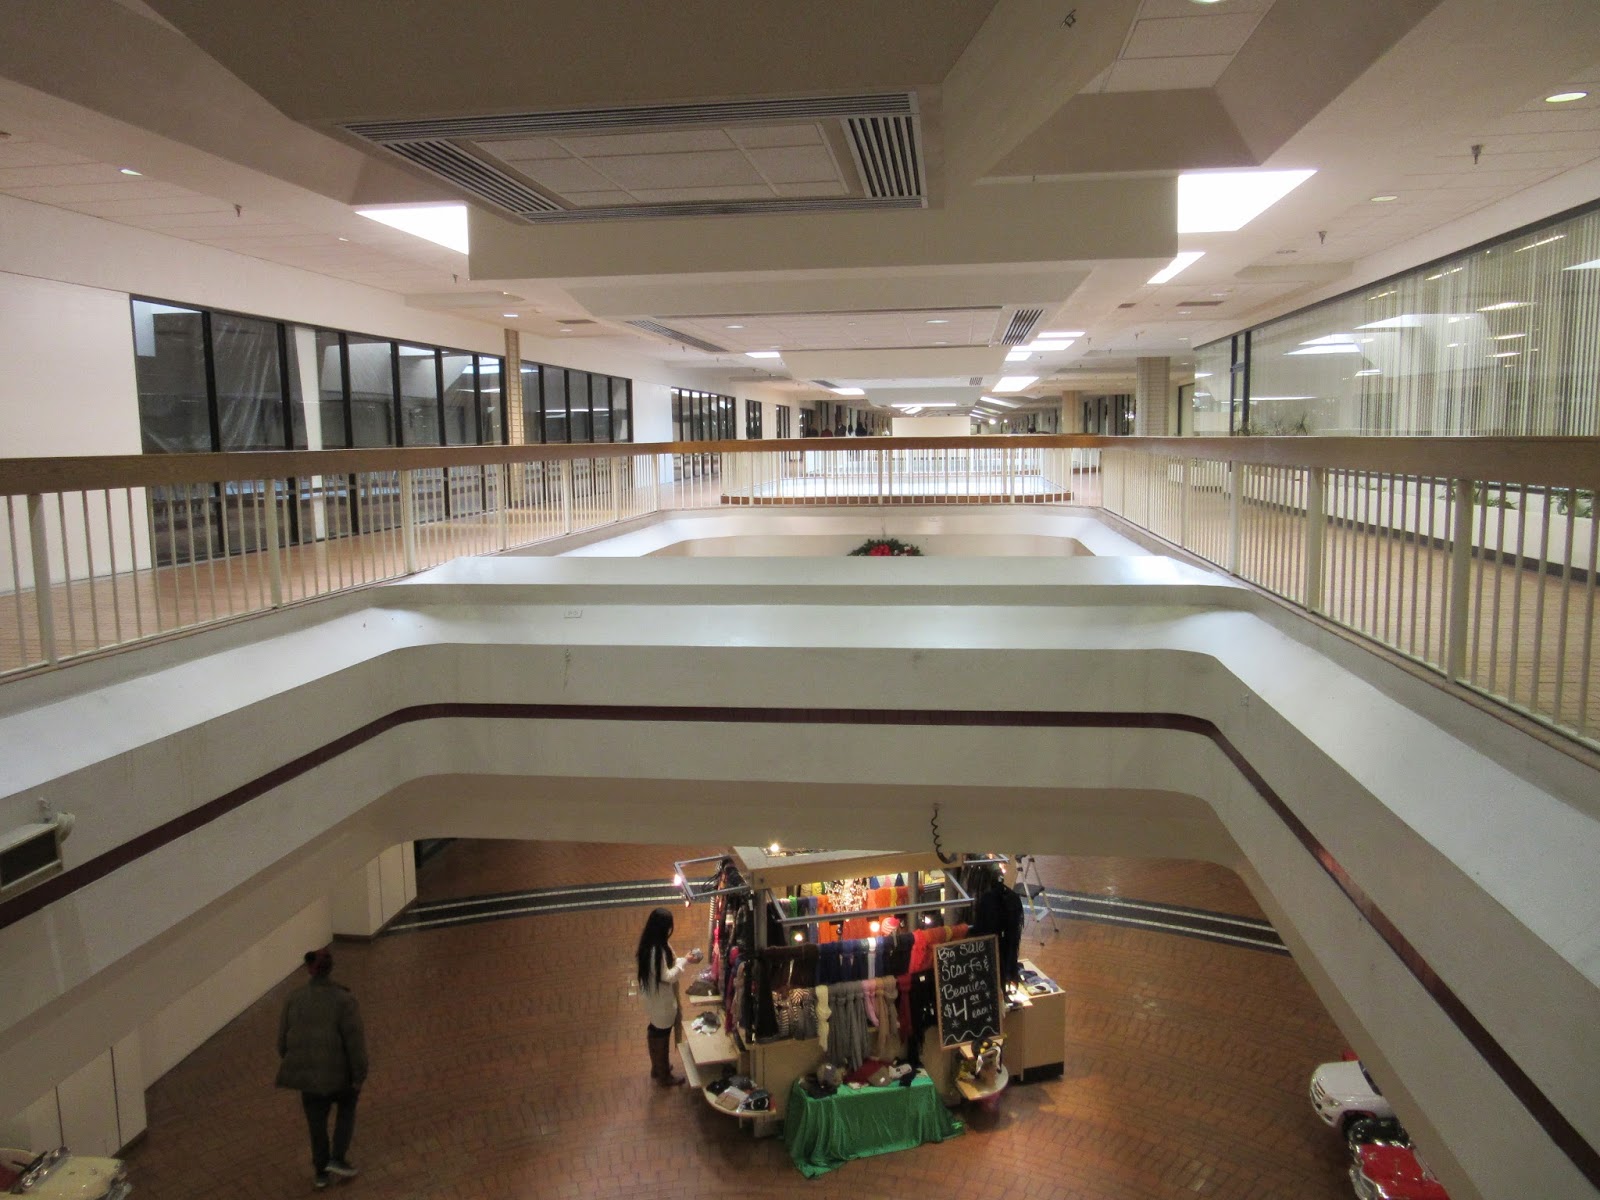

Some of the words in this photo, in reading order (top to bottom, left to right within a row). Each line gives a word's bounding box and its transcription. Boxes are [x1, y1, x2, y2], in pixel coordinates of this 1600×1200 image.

[938, 947, 956, 962] Big
[941, 957, 983, 981] Scarfs
[941, 980, 987, 1000] Beanies
